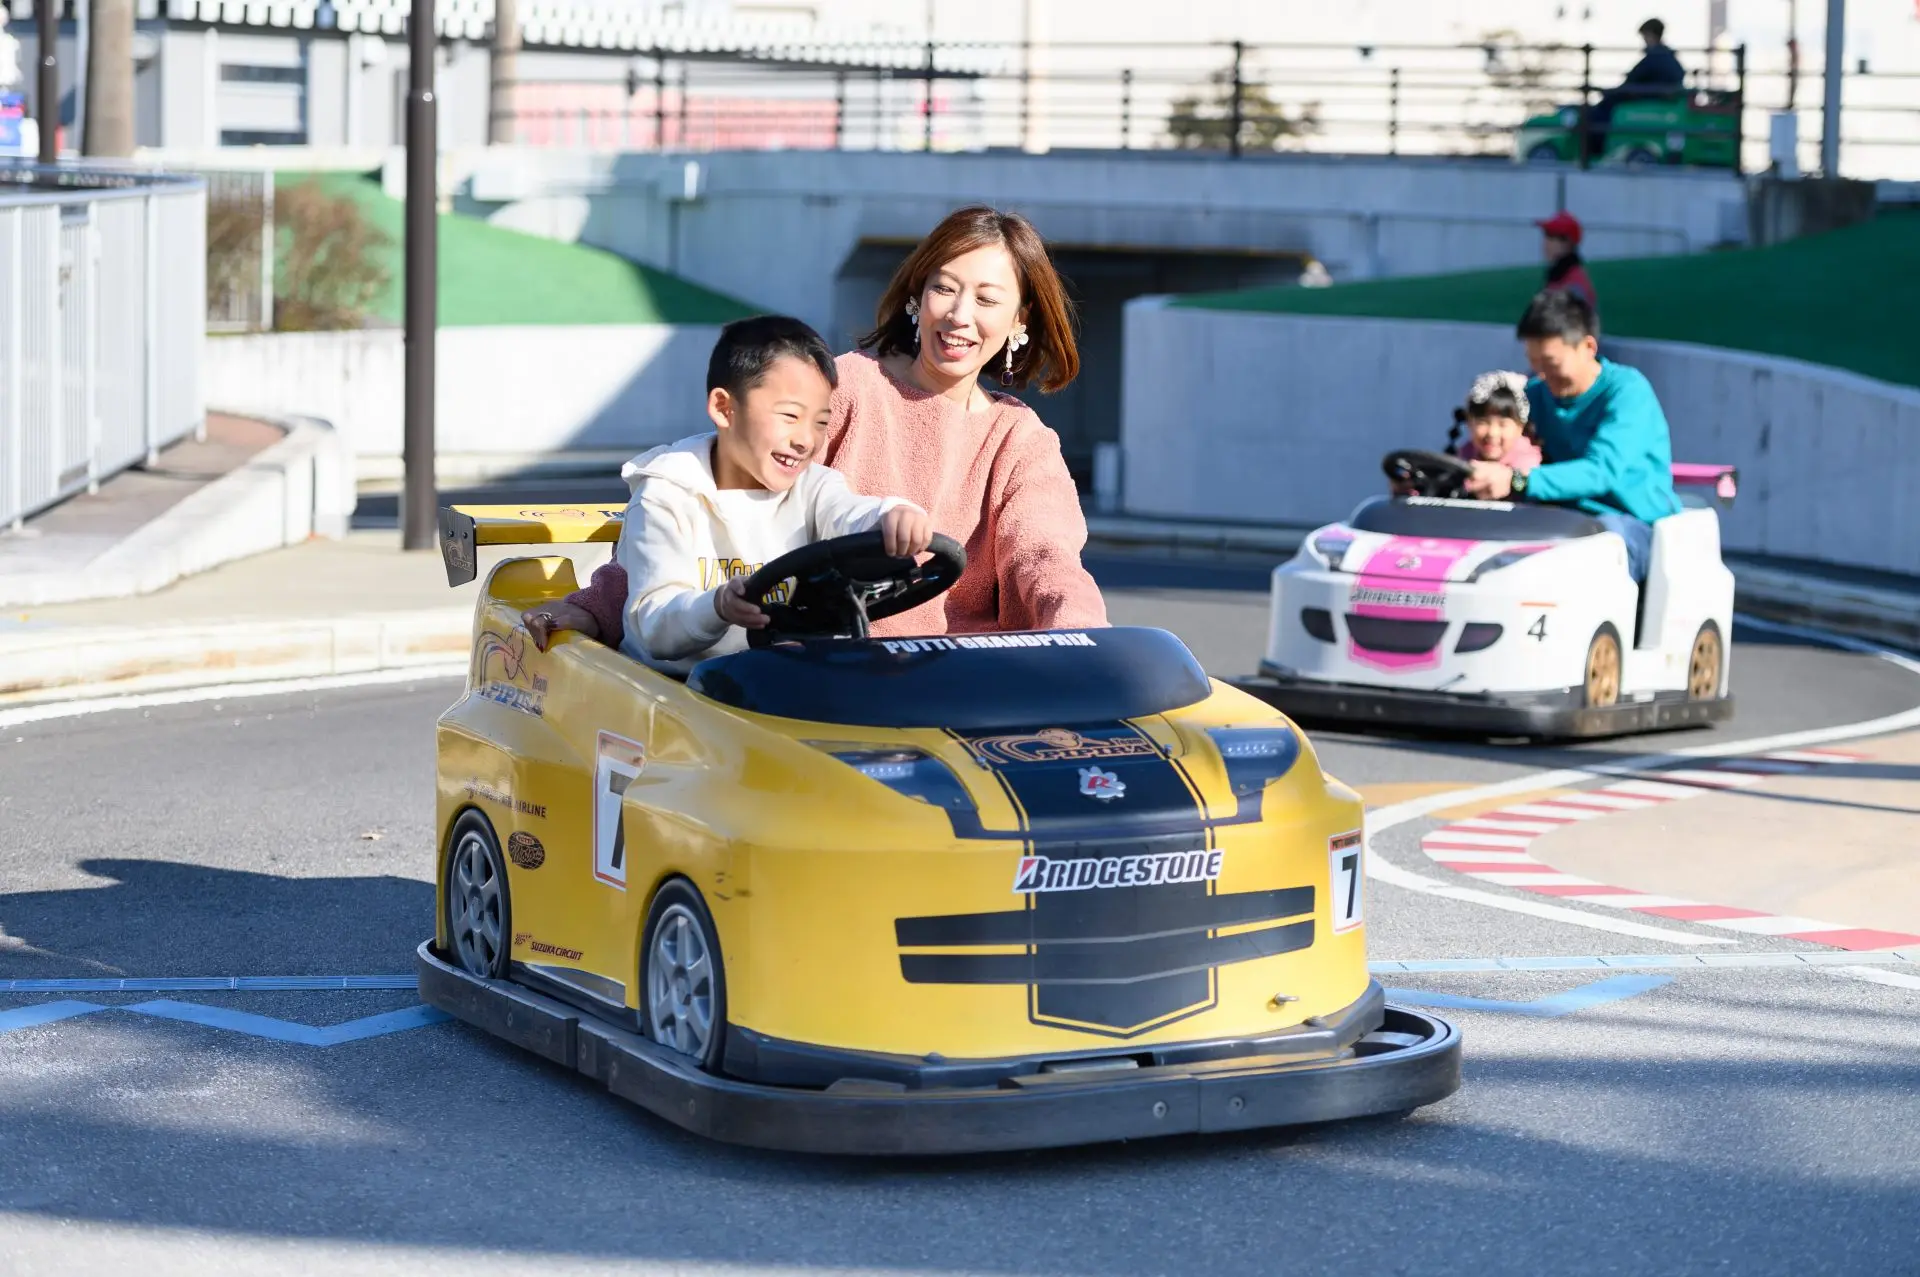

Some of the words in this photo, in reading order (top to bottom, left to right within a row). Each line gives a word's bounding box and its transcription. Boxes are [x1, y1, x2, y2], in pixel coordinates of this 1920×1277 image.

[1527, 613, 1548, 642] 4
[882, 638, 957, 655] PUTTI
[957, 633, 1098, 650] GRANDPRIX
[1016, 851, 1223, 891] BRIDGESTONE
[1341, 853, 1359, 920] 7
[531, 941, 555, 956] SUZUKA
[555, 947, 584, 961] CIRCUIT
